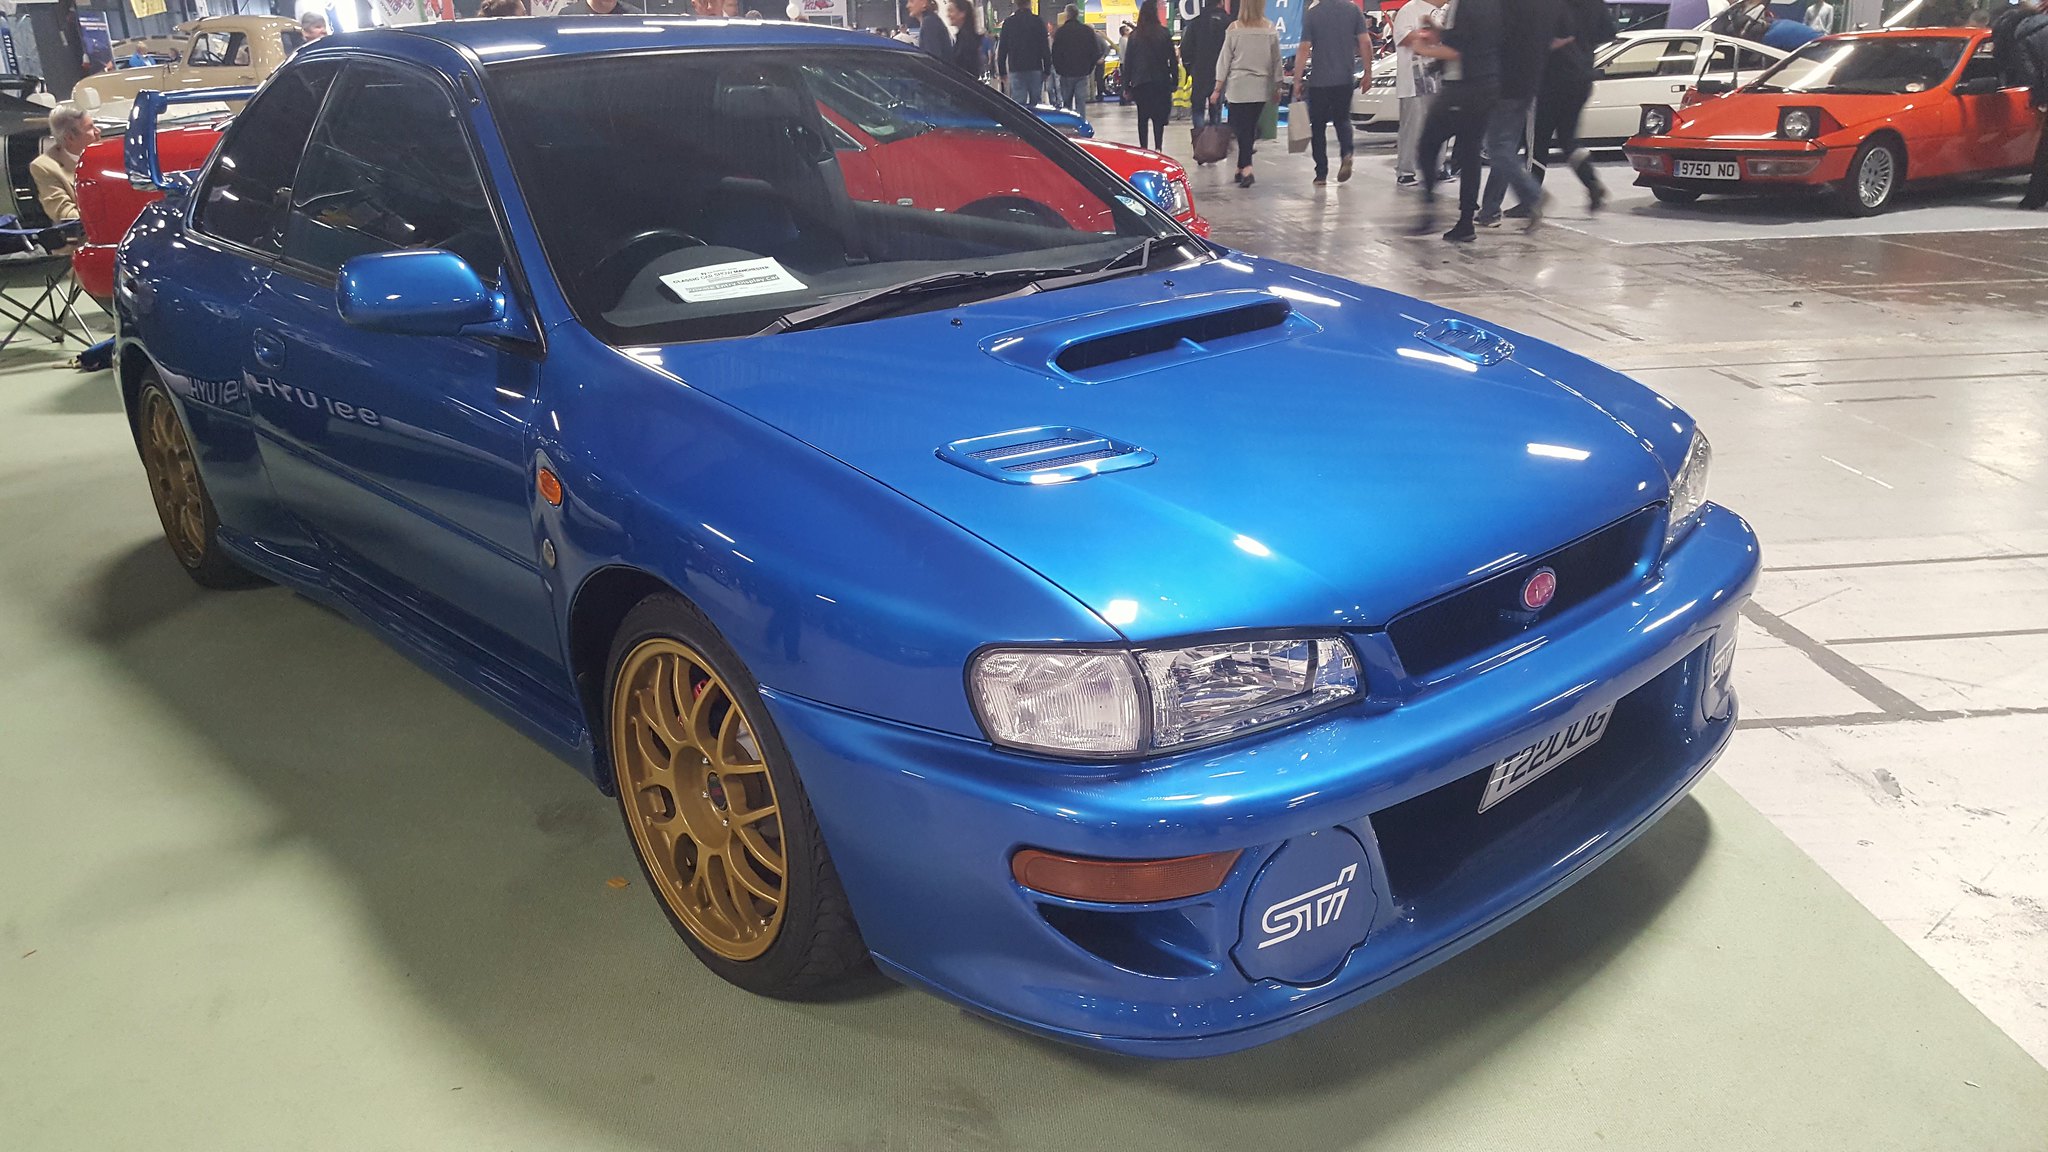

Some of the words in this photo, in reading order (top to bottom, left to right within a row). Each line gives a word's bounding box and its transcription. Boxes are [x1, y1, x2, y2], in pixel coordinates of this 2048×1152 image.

[1682, 162, 1710, 176] 9750
[1718, 164, 1735, 177] NO
[1343, 657, 1352, 667] W
